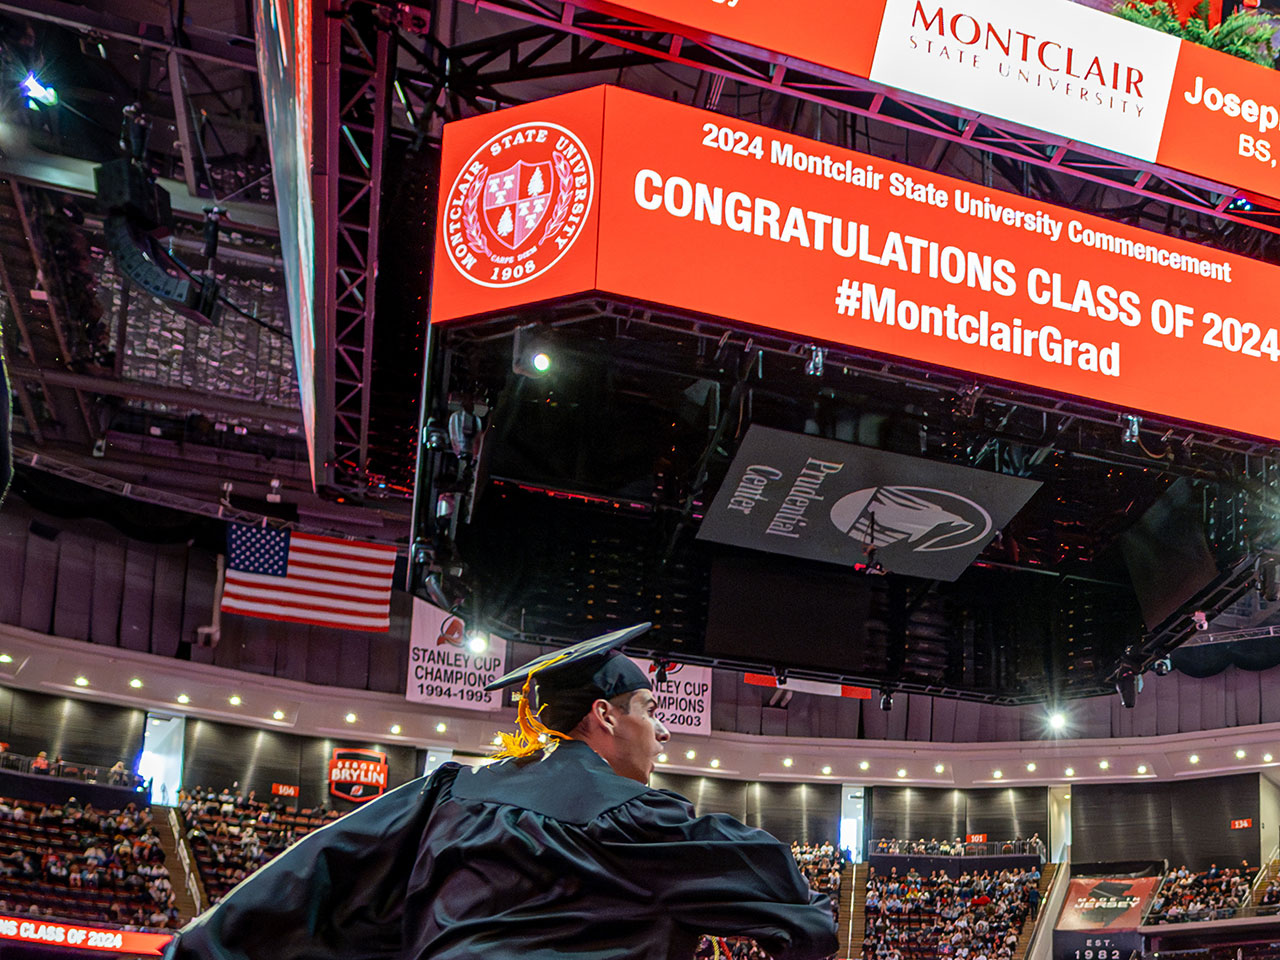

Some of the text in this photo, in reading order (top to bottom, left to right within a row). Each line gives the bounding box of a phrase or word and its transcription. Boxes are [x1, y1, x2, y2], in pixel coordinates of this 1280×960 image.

[911, 0, 1145, 98] MONTCLAIR
[908, 35, 1145, 118] STATE UNIVERSITY
[1238, 133, 1277, 167] BS,
[450, 129, 588, 270] MONTCLAIR STATE UNIVERSITY
[702, 123, 1232, 283] 2024 Montclair State University Commencement
[490, 260, 536, 280] 1908
[634, 169, 1280, 362] CONGRATULATIONS CLASS OF 2024
[834, 278, 1121, 377] #MontclairGrad
[726, 456, 845, 539] Prudential Center
[411, 647, 501, 672] STANLEY CUP
[414, 665, 496, 688] CHAMPIONS
[651, 678, 709, 697] NLEY CUP
[417, 683, 493, 704] 1994-1995
[656, 695, 705, 714] MPIONS
[654, 711, 702, 727] 2-2003
[331, 768, 385, 785] BRYLIN
[1074, 899, 1140, 909] JERSEY
[20, 922, 65, 943] CLASS
[67, 928, 86, 945] OF
[87, 931, 122, 948] 2024
[1086, 939, 1115, 947] EST.
[1074, 950, 1120, 960] 1982
